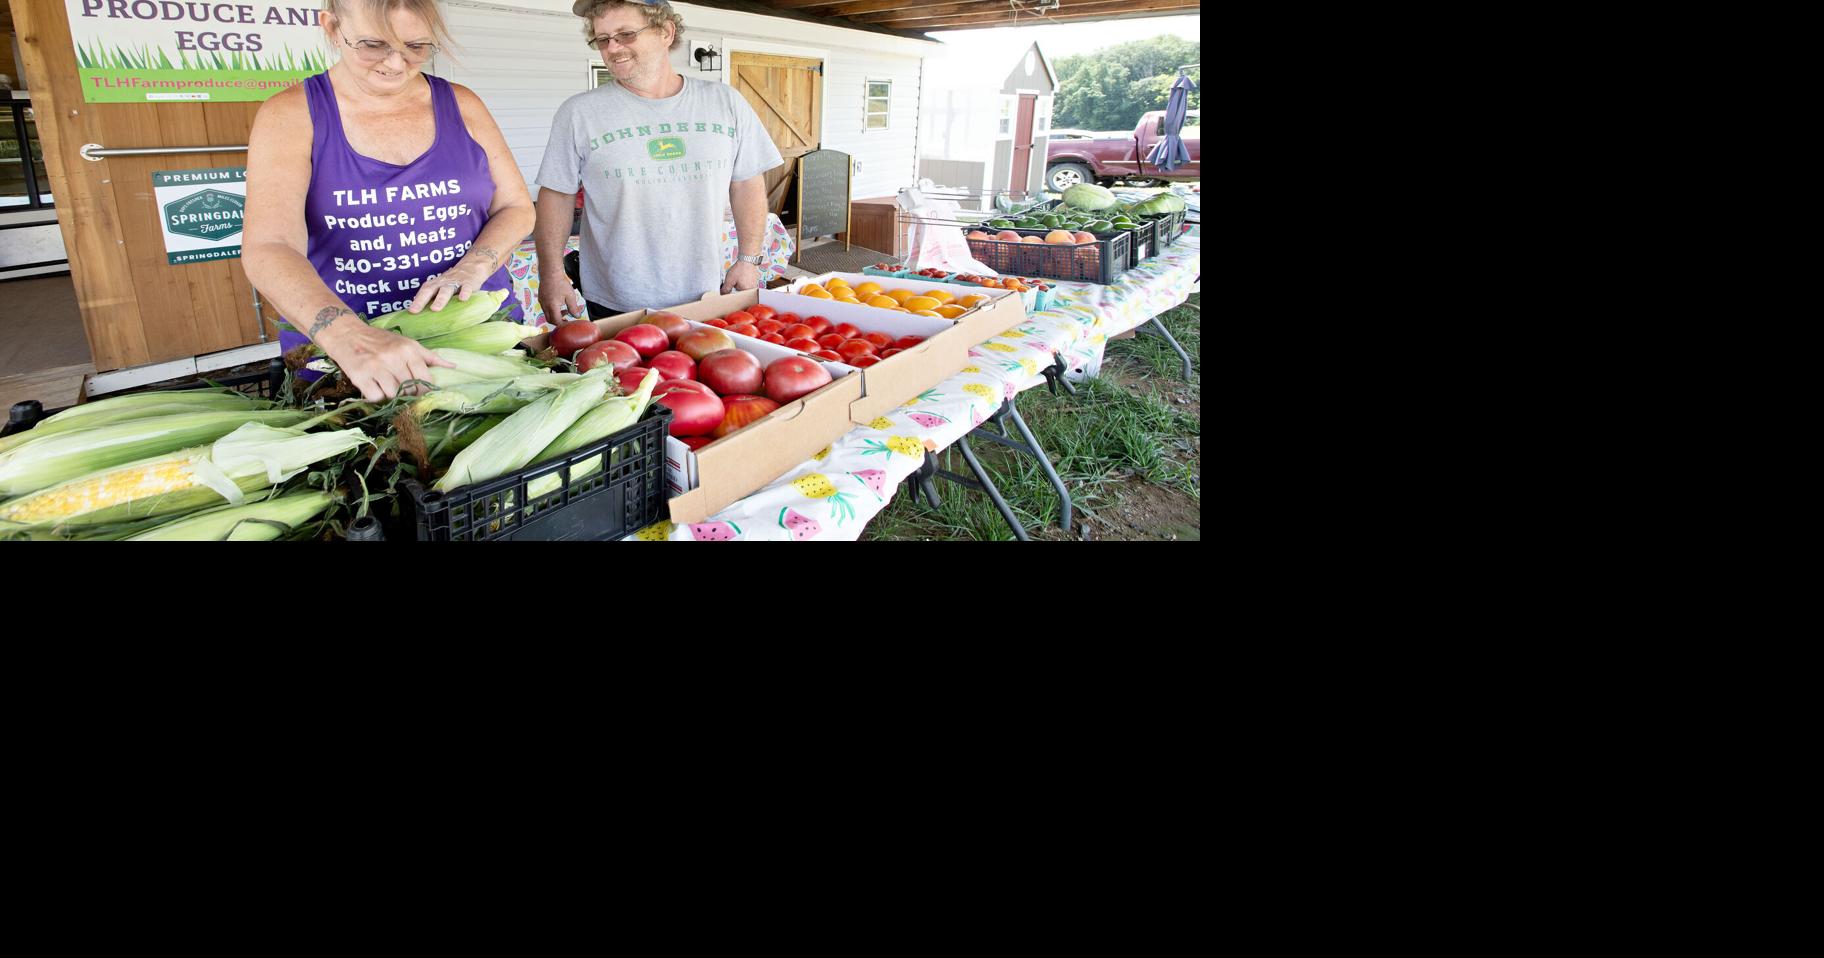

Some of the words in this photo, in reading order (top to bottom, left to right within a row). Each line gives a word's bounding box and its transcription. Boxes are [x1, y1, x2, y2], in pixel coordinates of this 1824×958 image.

[81, 0, 256, 24] PRODUCE
[175, 31, 263, 52] EGGS
[90, 76, 303, 90] TLHFarmproduce@gmail
[590, 125, 652, 151] JOHN
[658, 122, 736, 139] DEERE
[163, 171, 230, 183] PREMIUM
[604, 167, 647, 179] PURE
[333, 188, 378, 206] TLH
[385, 179, 461, 203] FARMS
[171, 209, 244, 226] SPRINGDAL
[324, 212, 415, 230] Produce,
[422, 203, 472, 222] Eggs,
[200, 222, 233, 234] Farms
[350, 235, 392, 251] and,
[399, 226, 456, 248] Meats
[335, 279, 391, 295] Check
[397, 277, 420, 291] us
[366, 297, 416, 315] Face
